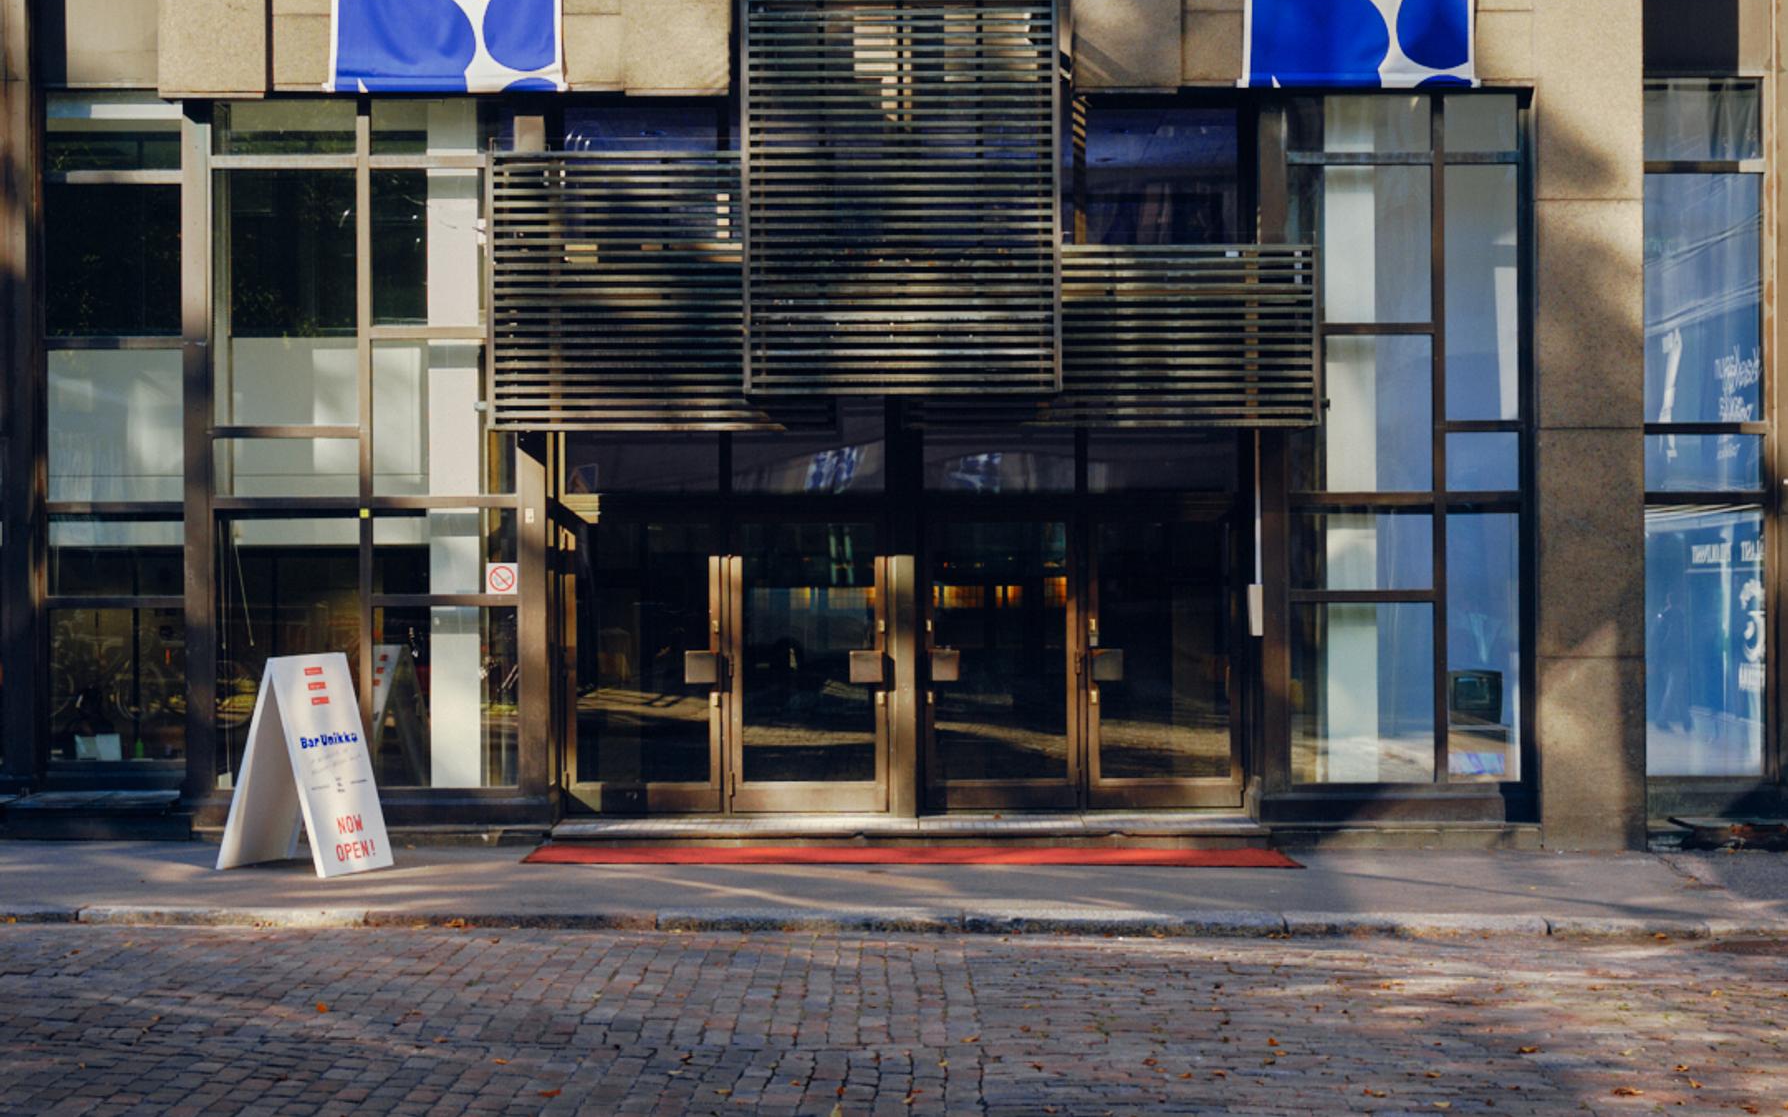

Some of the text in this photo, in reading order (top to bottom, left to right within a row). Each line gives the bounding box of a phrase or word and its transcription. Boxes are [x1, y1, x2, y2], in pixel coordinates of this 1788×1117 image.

[300, 732, 358, 749] Bar Unikko
[336, 814, 363, 834] NOW
[336, 839, 376, 862] OPEN!
